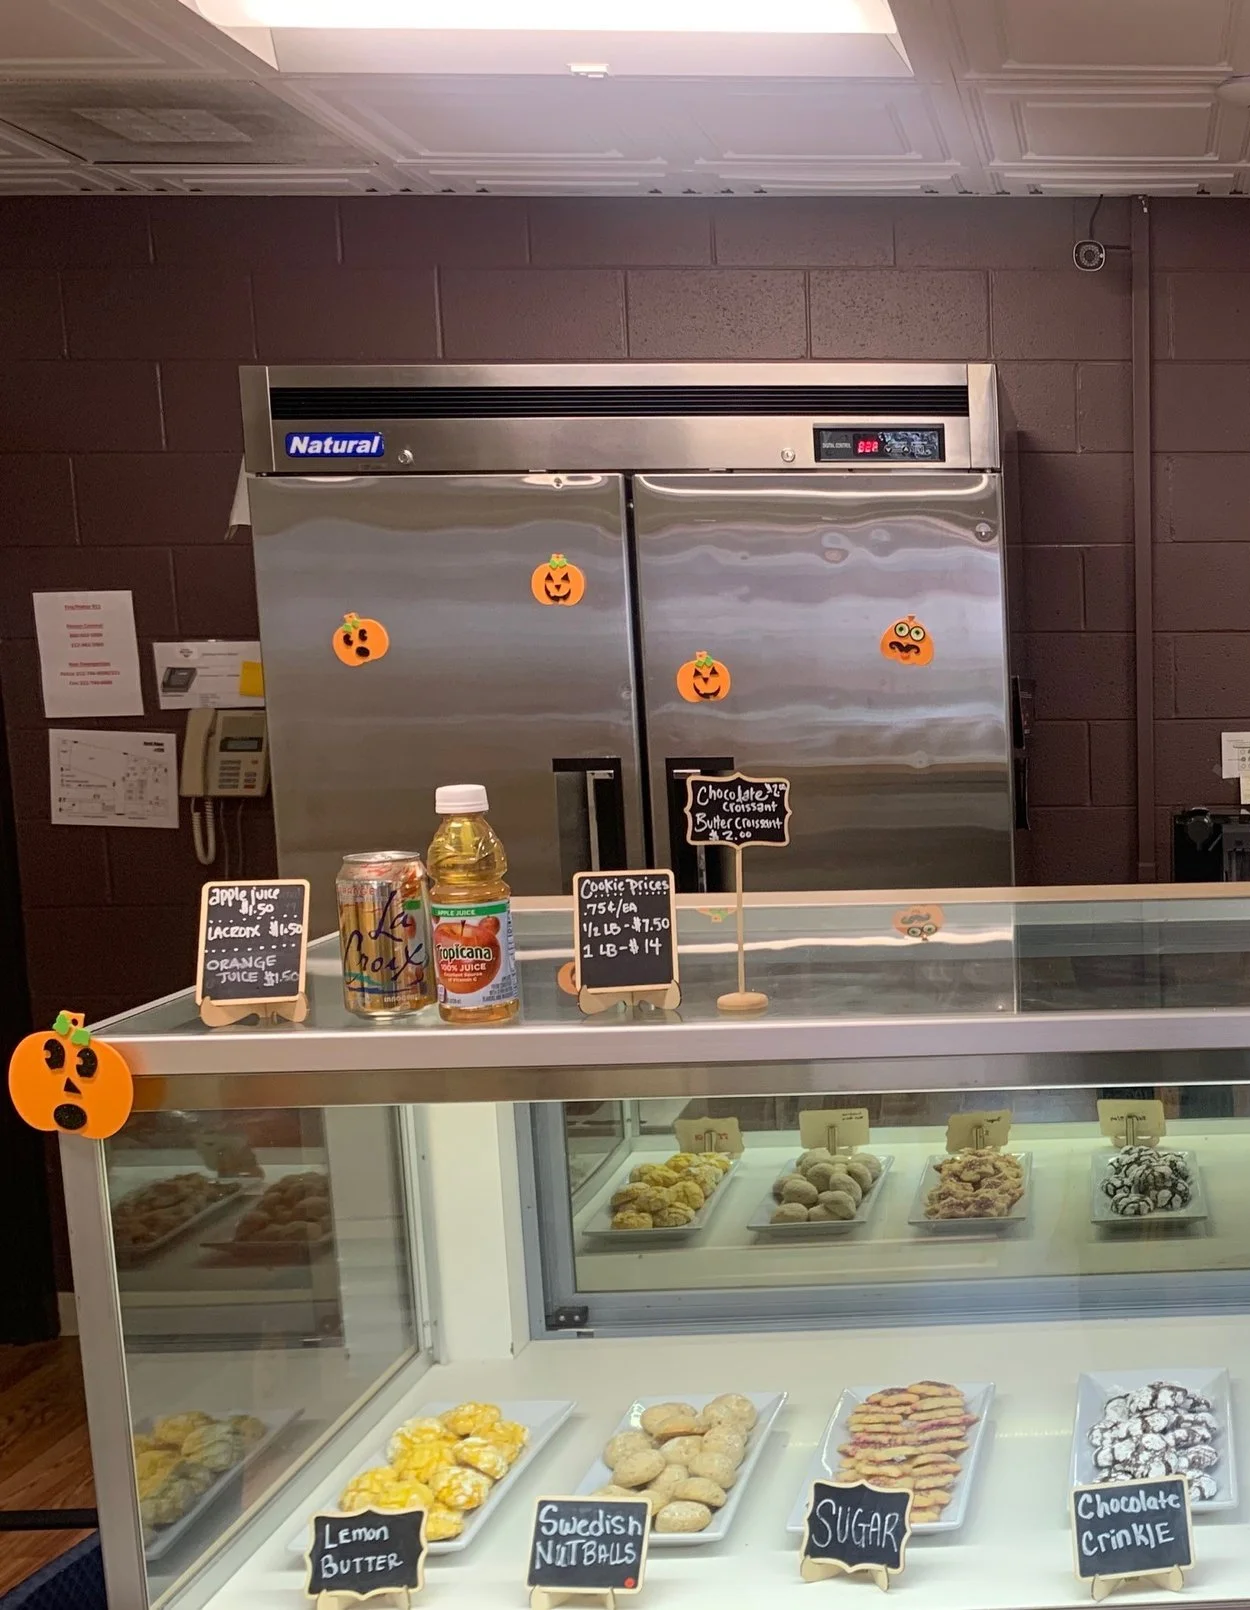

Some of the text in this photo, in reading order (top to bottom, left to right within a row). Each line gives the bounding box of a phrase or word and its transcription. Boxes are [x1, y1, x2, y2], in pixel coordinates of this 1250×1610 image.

[289, 435, 380, 454] Natural
[696, 784, 769, 806] Chocolate
[694, 812, 733, 833] Butter
[208, 886, 280, 907] apple juice
[580, 876, 670, 899] Cookie Prices
[239, 900, 274, 916] $1.50
[368, 890, 413, 943] La
[208, 920, 303, 941] LACROIX $1.50
[582, 921, 601, 938] 1/2
[604, 922, 621, 936] LB
[631, 916, 670, 933] $7.50
[344, 930, 424, 985] Croix
[436, 944, 493, 964] Tropicana
[583, 944, 594, 958] 1
[599, 943, 618, 957] LB
[206, 955, 277, 971] ORANGE
[460, 963, 487, 972] JUICE
[215, 970, 300, 986] JUICE $1.50
[1077, 1489, 1181, 1520] Chocolate
[539, 1504, 643, 1537] Swedish
[811, 1498, 900, 1553] SUGAR
[320, 1552, 404, 1579] BUTTER
